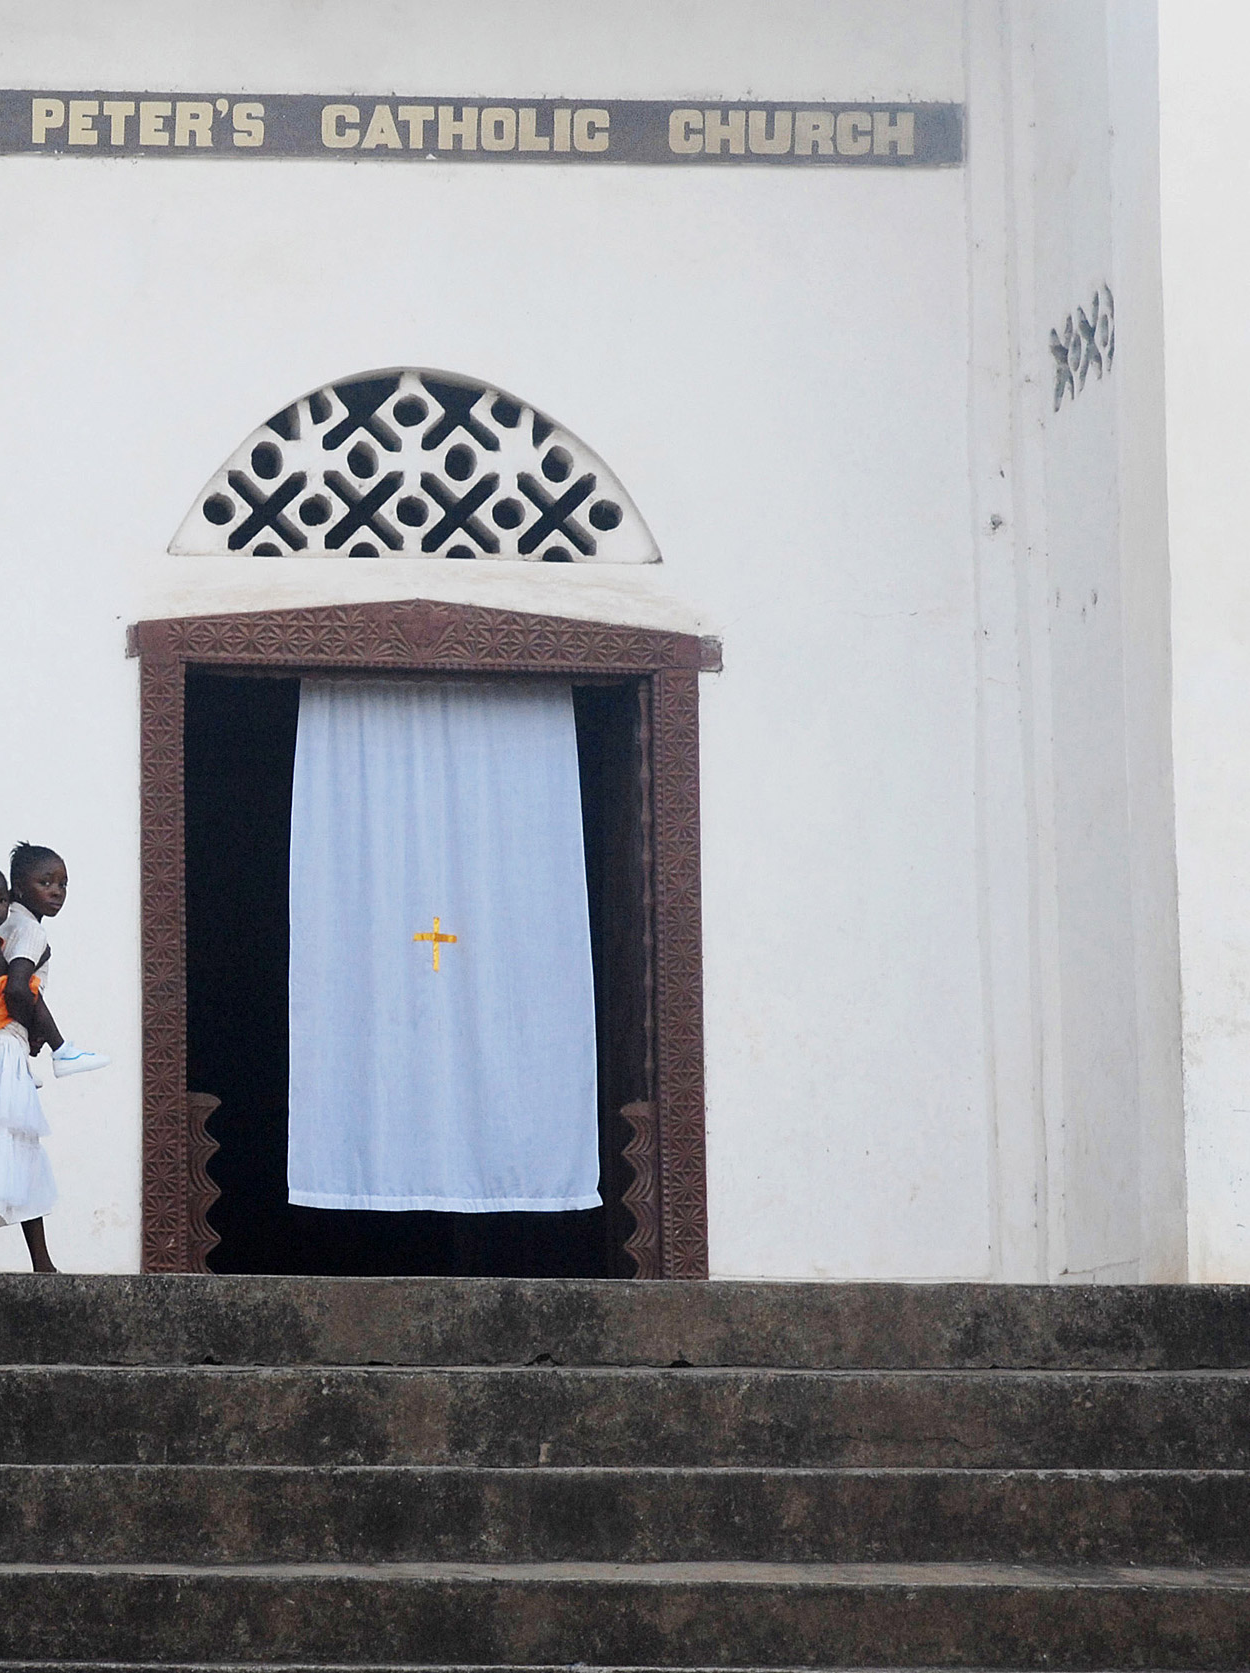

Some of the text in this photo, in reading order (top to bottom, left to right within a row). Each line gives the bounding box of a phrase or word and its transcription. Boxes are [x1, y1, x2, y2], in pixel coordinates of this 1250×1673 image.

[32, 98, 265, 147] PETER'S
[321, 104, 610, 152] CATHOLIC
[668, 109, 915, 156] CHURCH
